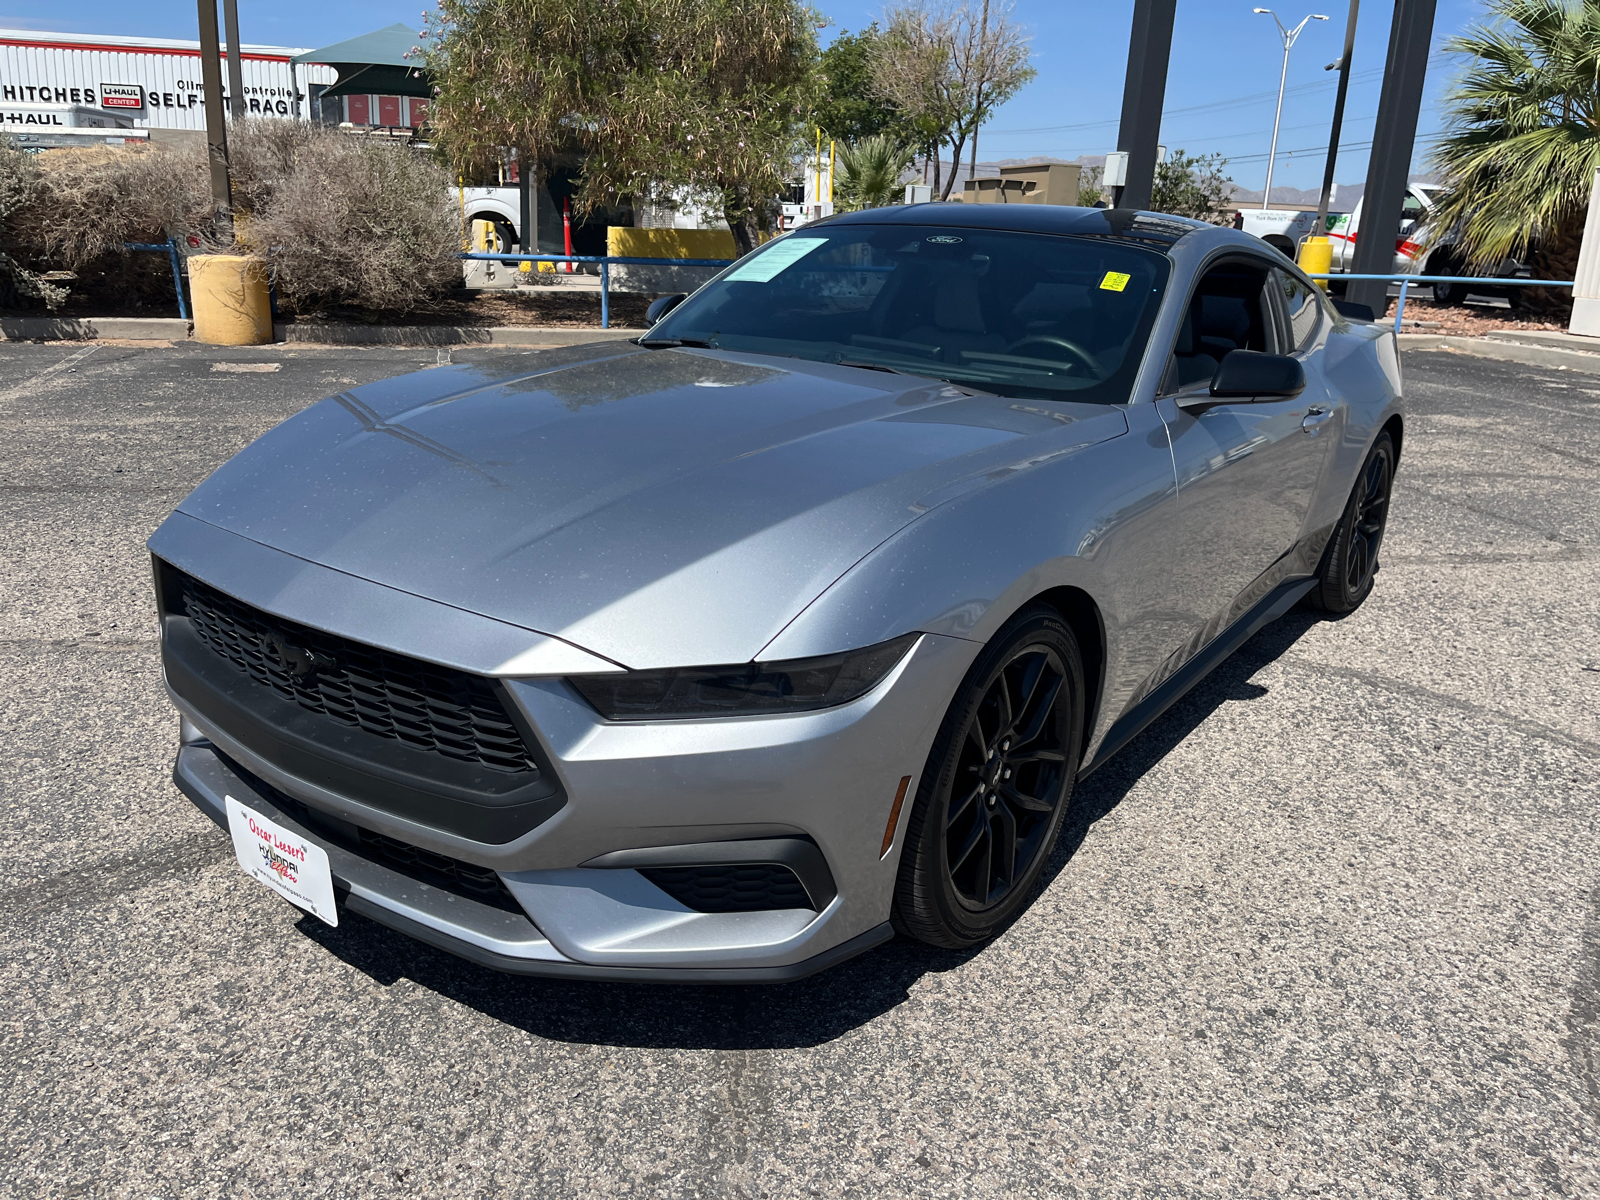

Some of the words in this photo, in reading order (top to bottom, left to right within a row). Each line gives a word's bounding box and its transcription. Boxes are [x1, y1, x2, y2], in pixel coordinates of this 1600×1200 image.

[3, 85, 96, 103] HITCHES
[104, 88, 138, 96] U-HAUL
[243, 86, 300, 97] ontrolle
[249, 818, 272, 844] Oscar
[274, 834, 305, 862] Leeser's
[258, 843, 299, 874] HYUNDAI
[271, 861, 280, 872] El
[279, 864, 298, 883] Paso
